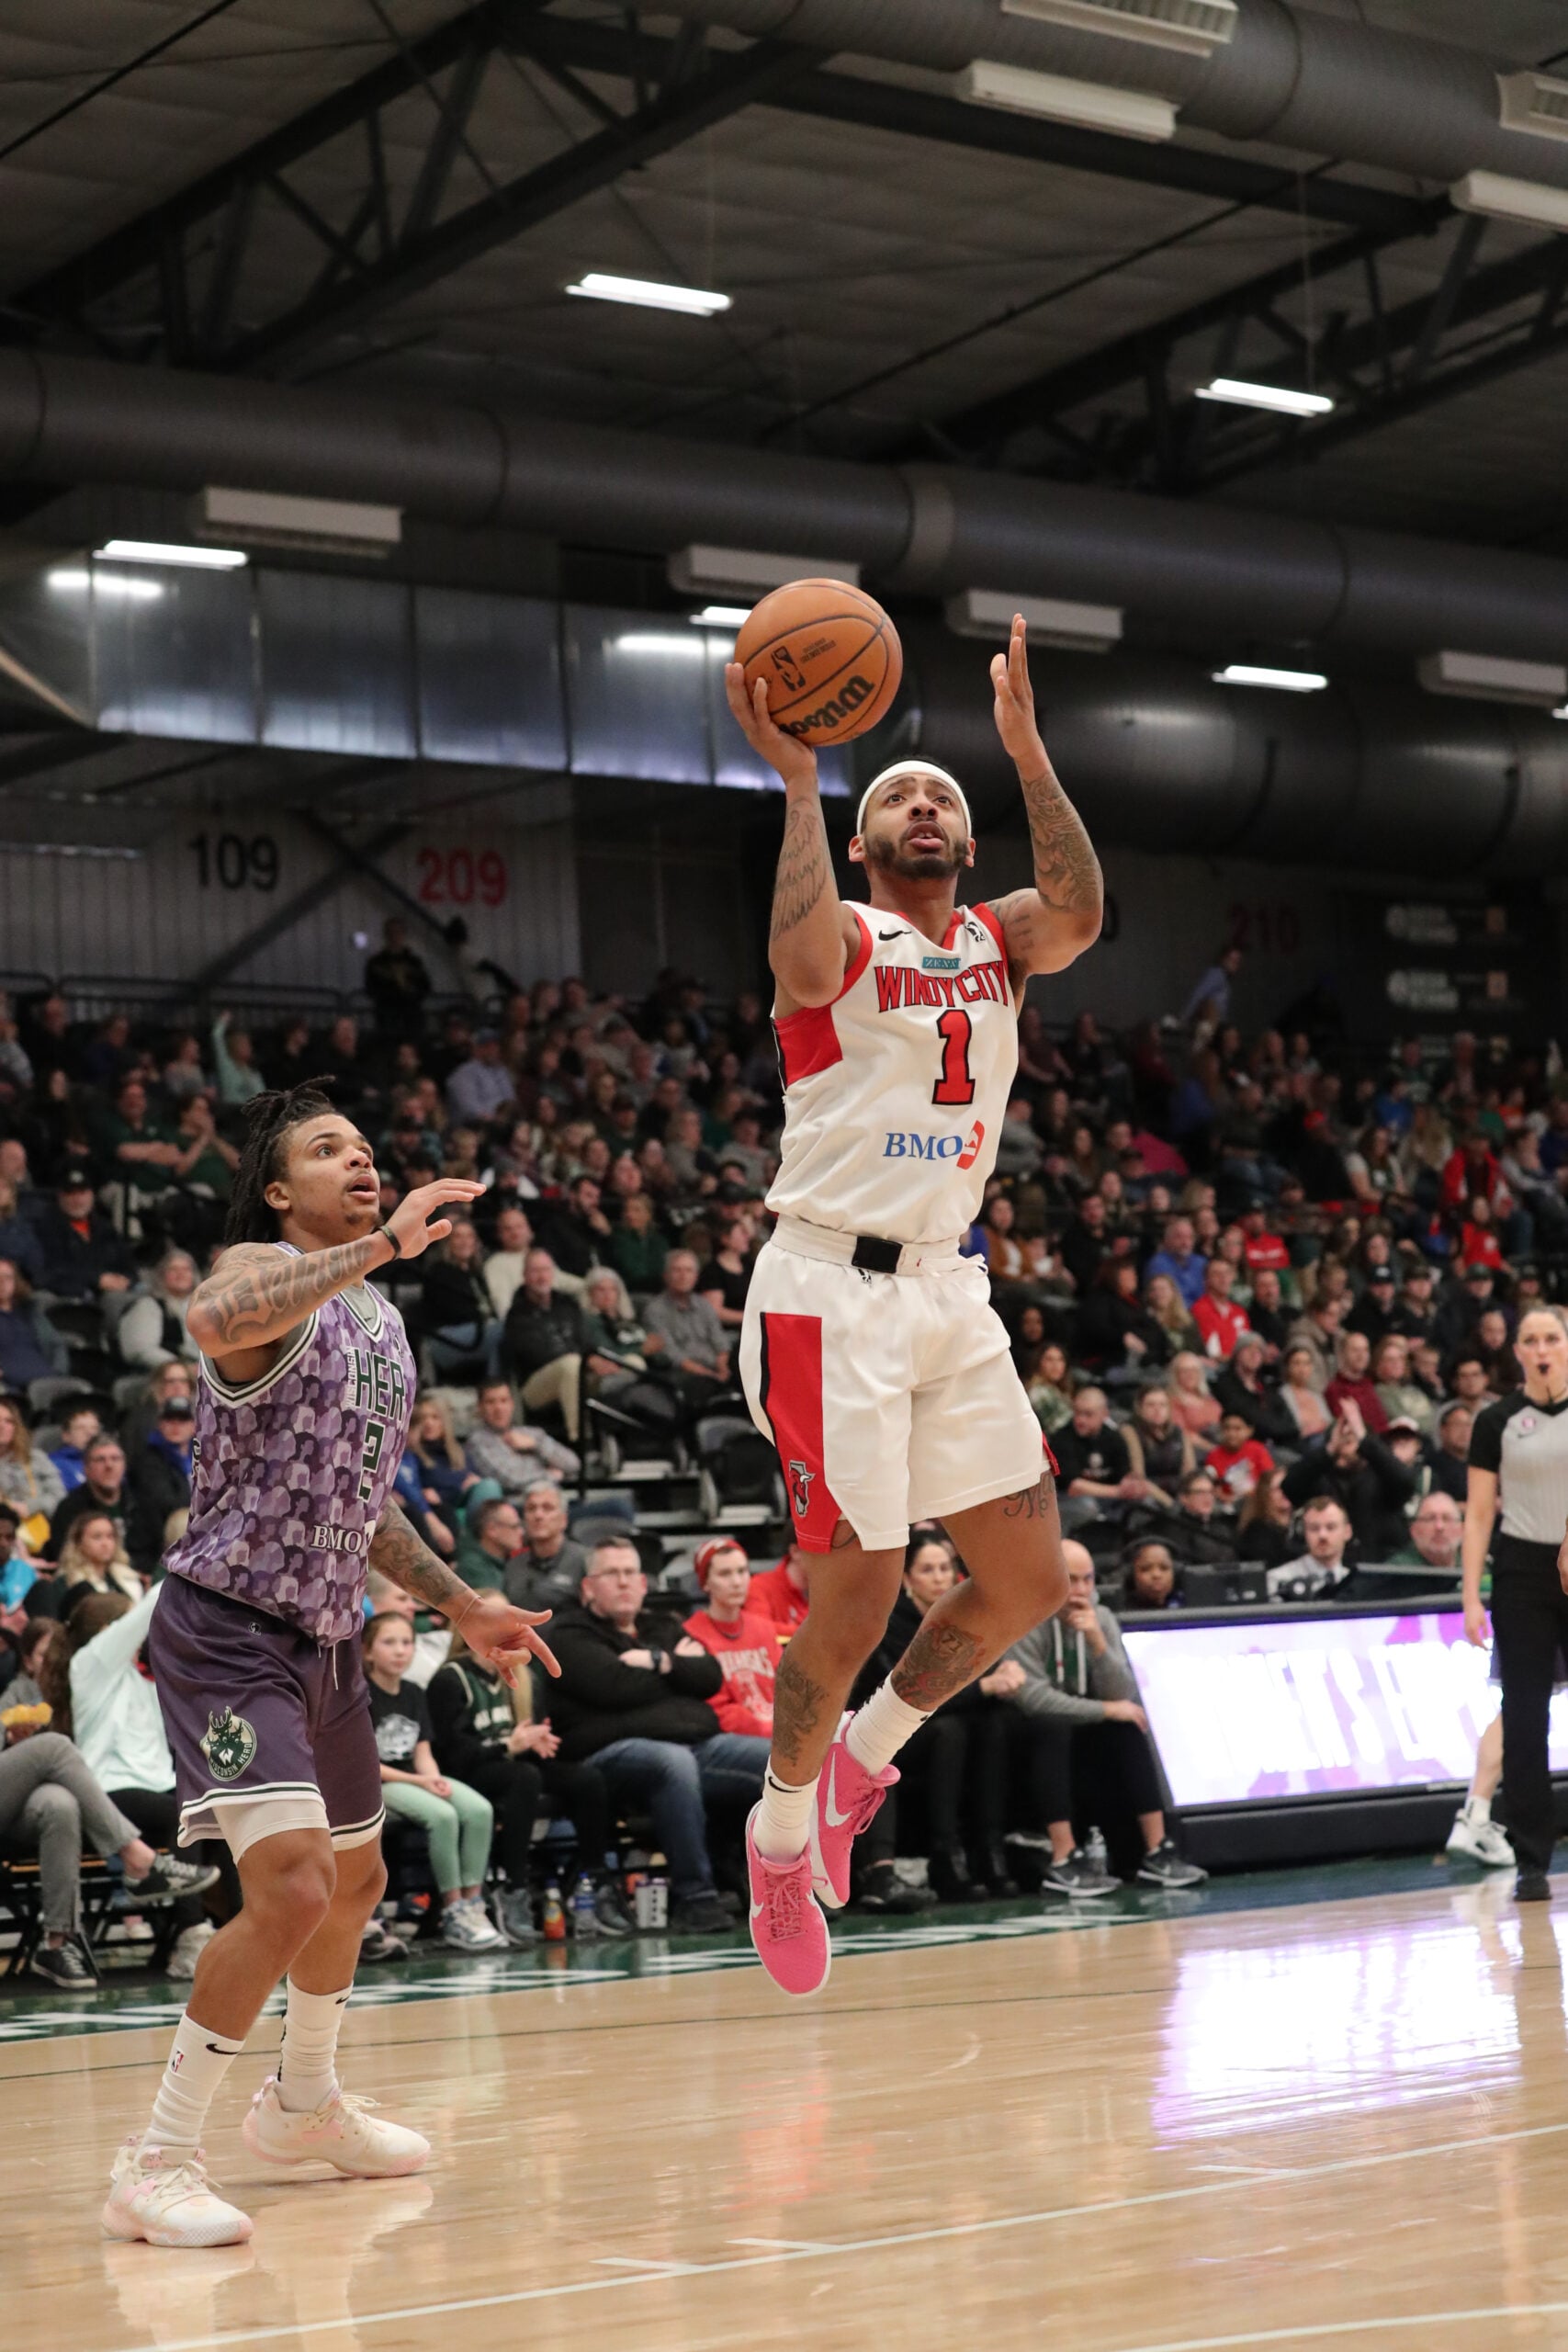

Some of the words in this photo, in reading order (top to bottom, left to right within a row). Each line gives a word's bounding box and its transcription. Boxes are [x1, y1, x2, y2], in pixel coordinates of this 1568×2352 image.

[189, 832, 279, 892] 109
[416, 847, 508, 907] 209
[874, 966, 955, 1012] WINDY
[954, 960, 1009, 1008] CITY
[931, 1009, 976, 1105] 1
[882, 1132, 963, 1160] BMO
[356, 1419, 386, 1503] 2
[310, 1524, 363, 1554] BMO
